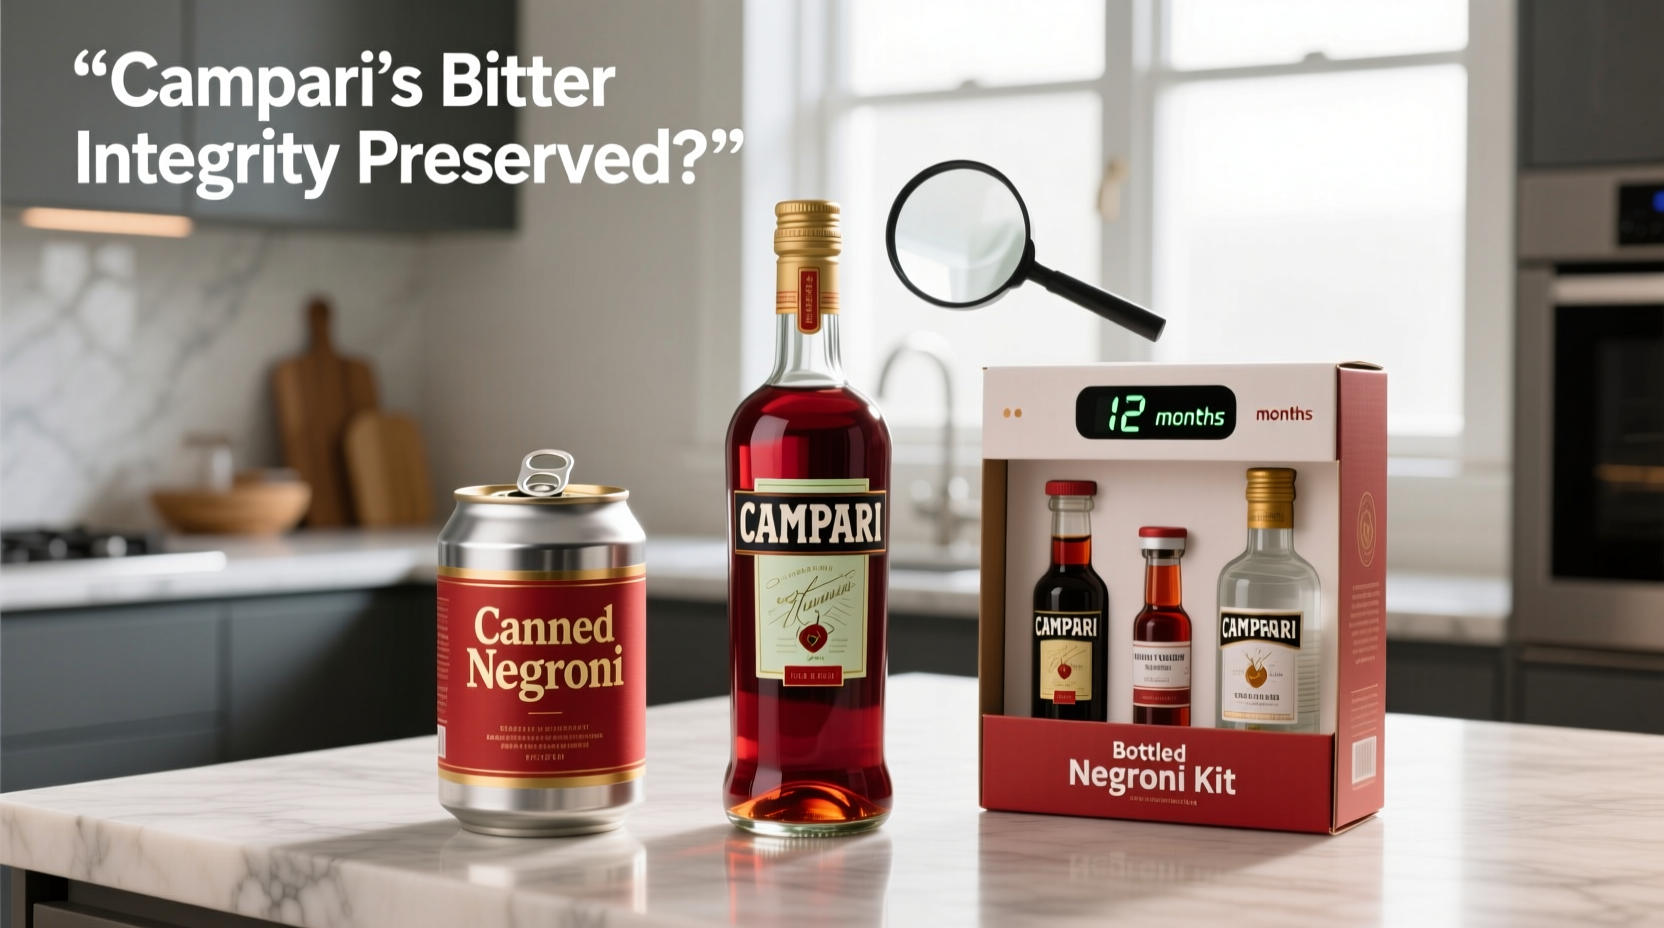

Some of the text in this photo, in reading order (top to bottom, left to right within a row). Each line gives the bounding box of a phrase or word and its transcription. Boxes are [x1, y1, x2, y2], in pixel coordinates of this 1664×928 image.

[1109, 395, 1225, 432] 12 months
[1256, 406, 1313, 421] months
[739, 501, 882, 544] CAMPARI
[474, 603, 615, 645] Canned
[1035, 616, 1097, 637] CAMPARI
[466, 644, 624, 702] Negroni
[1113, 740, 1186, 763] Bottled
[1069, 758, 1236, 797] Negroni Kit
